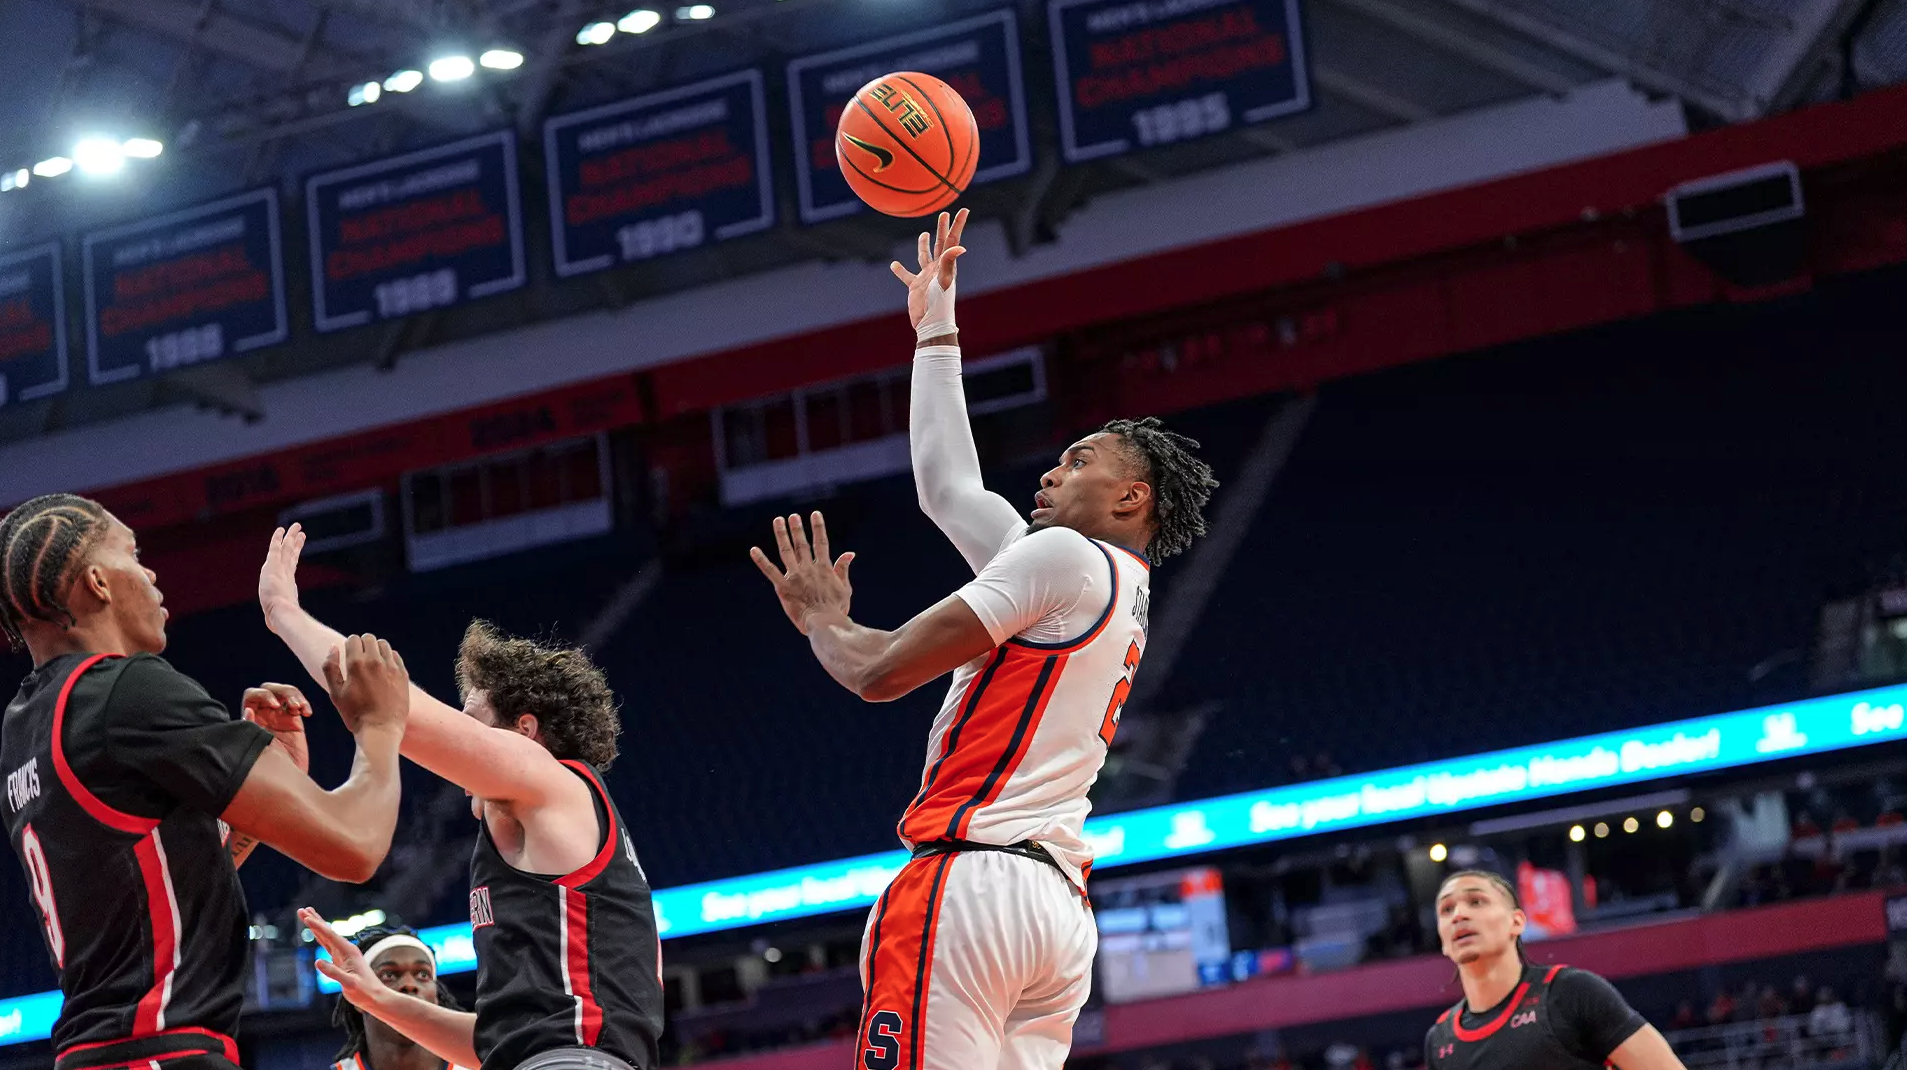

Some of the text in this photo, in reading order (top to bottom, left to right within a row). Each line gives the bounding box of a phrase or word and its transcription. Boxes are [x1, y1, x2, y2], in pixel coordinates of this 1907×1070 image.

[869, 83, 930, 141] ELITE
[8, 757, 41, 813] FRANCIS
[22, 822, 65, 969] 9
[864, 1010, 903, 1070] S
[1510, 1010, 1537, 1029] CAA
